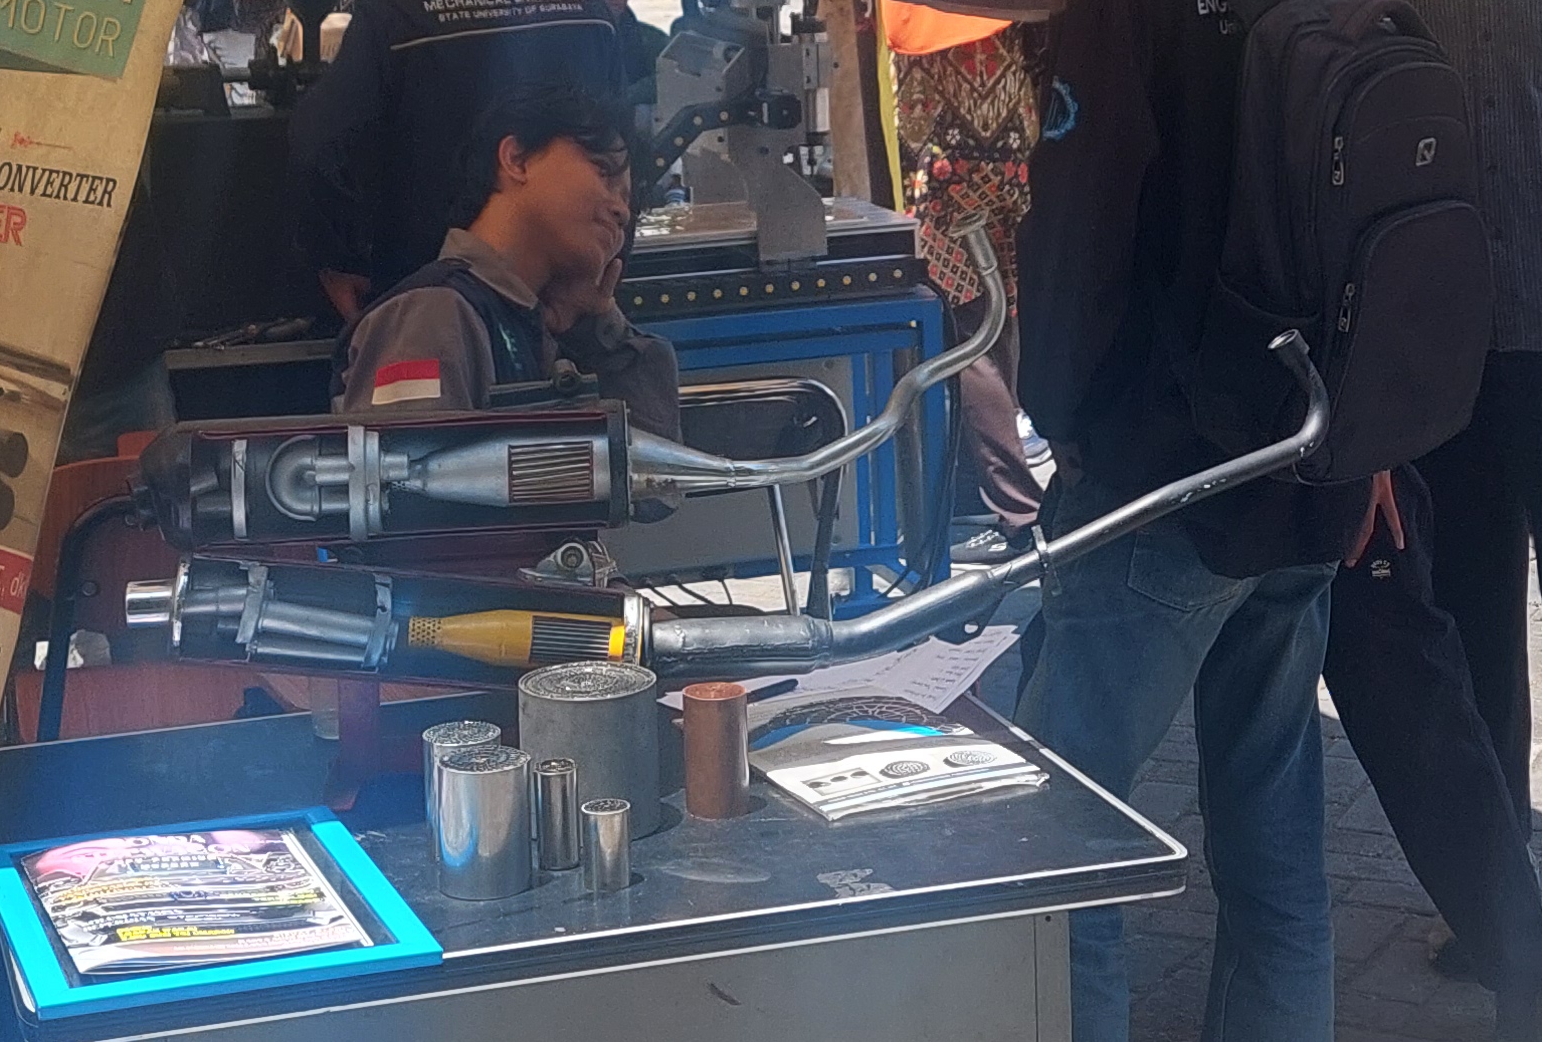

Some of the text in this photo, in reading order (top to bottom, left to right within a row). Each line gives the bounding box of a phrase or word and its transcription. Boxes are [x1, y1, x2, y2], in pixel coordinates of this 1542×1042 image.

[438, 10, 471, 23] STATE
[473, 7, 522, 19] UNIVERSITY
[525, 5, 537, 14] OF
